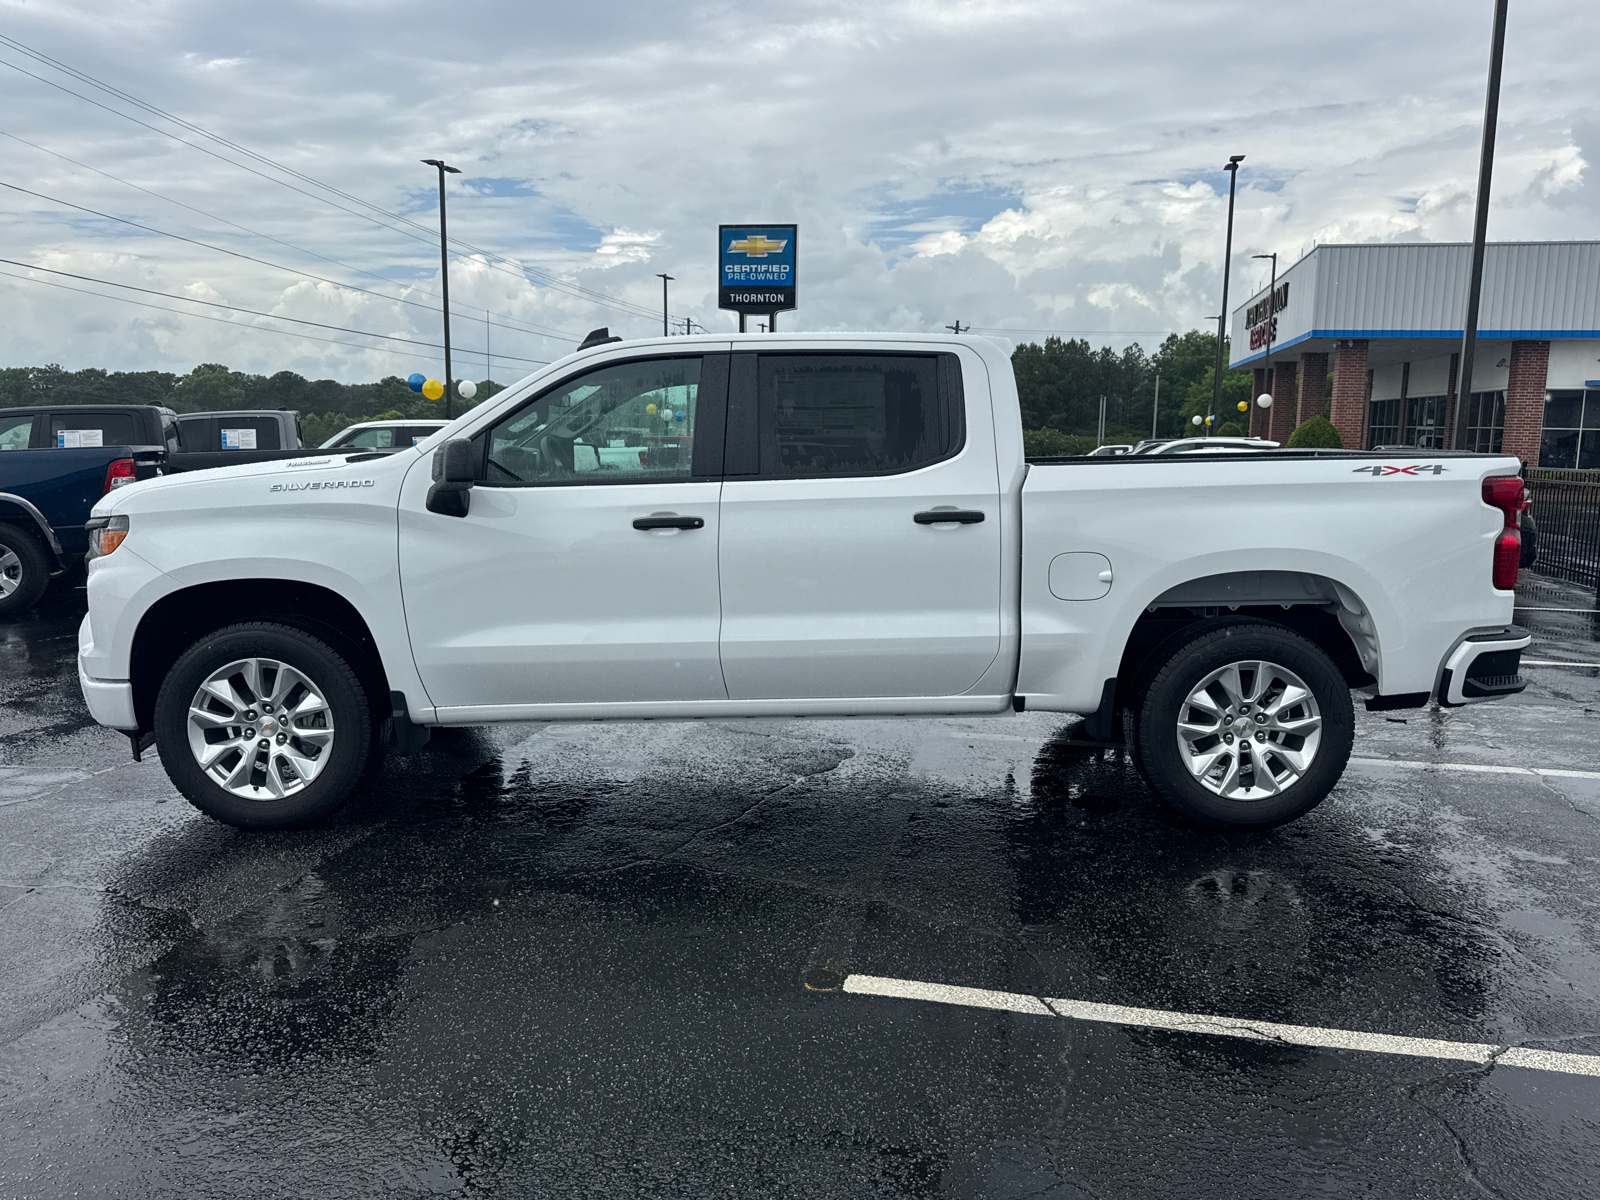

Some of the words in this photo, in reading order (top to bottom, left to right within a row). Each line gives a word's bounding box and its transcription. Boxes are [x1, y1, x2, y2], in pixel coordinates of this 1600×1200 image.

[725, 264, 790, 272] CERTIFIED
[728, 272, 787, 280] PRE-OWNED
[730, 293, 784, 303] THORNTON
[270, 479, 375, 493] SILVERADO
